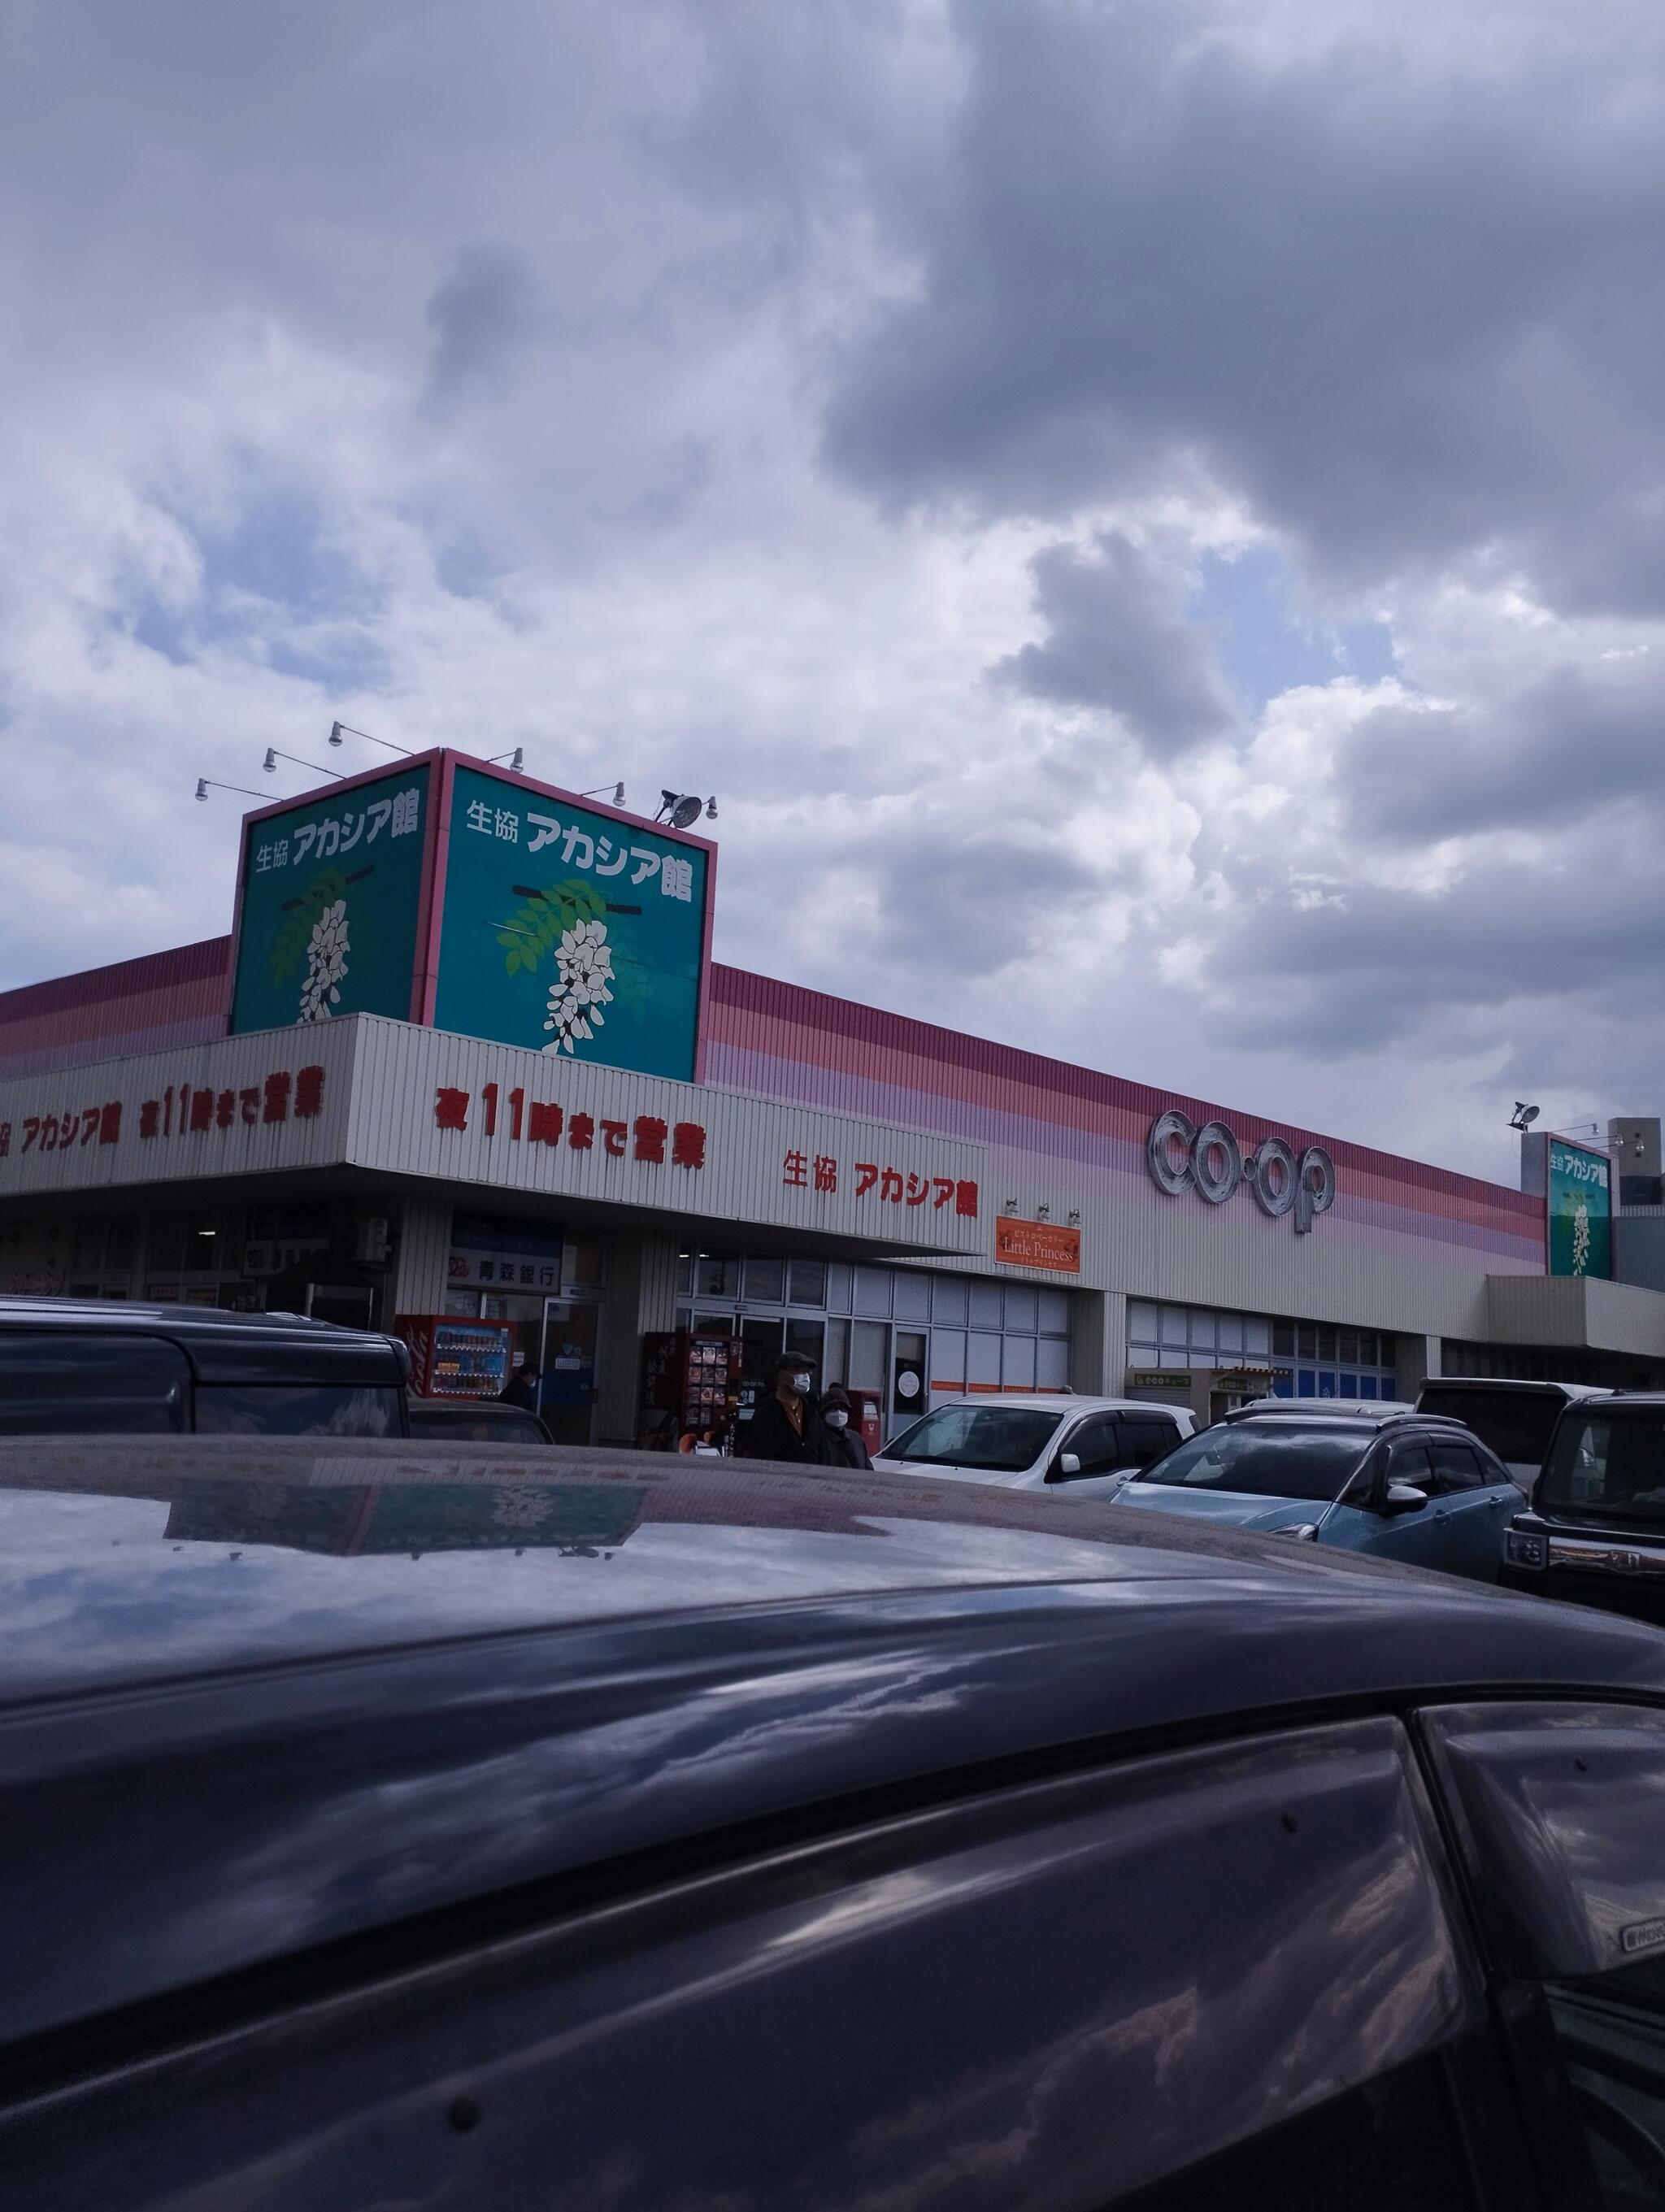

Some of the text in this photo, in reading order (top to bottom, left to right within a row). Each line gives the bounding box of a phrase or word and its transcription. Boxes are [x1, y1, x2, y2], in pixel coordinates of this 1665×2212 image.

[255, 788, 420, 872] 生協 アカシア館
[467, 799, 693, 902] 生協 アカシア館
[21, 1101, 122, 1154] アカシア館
[783, 1149, 977, 1218] 生協 アカシア館
[479, 1260, 554, 1286] 青森銀行
[1004, 1236, 1074, 1262] Little Princess
